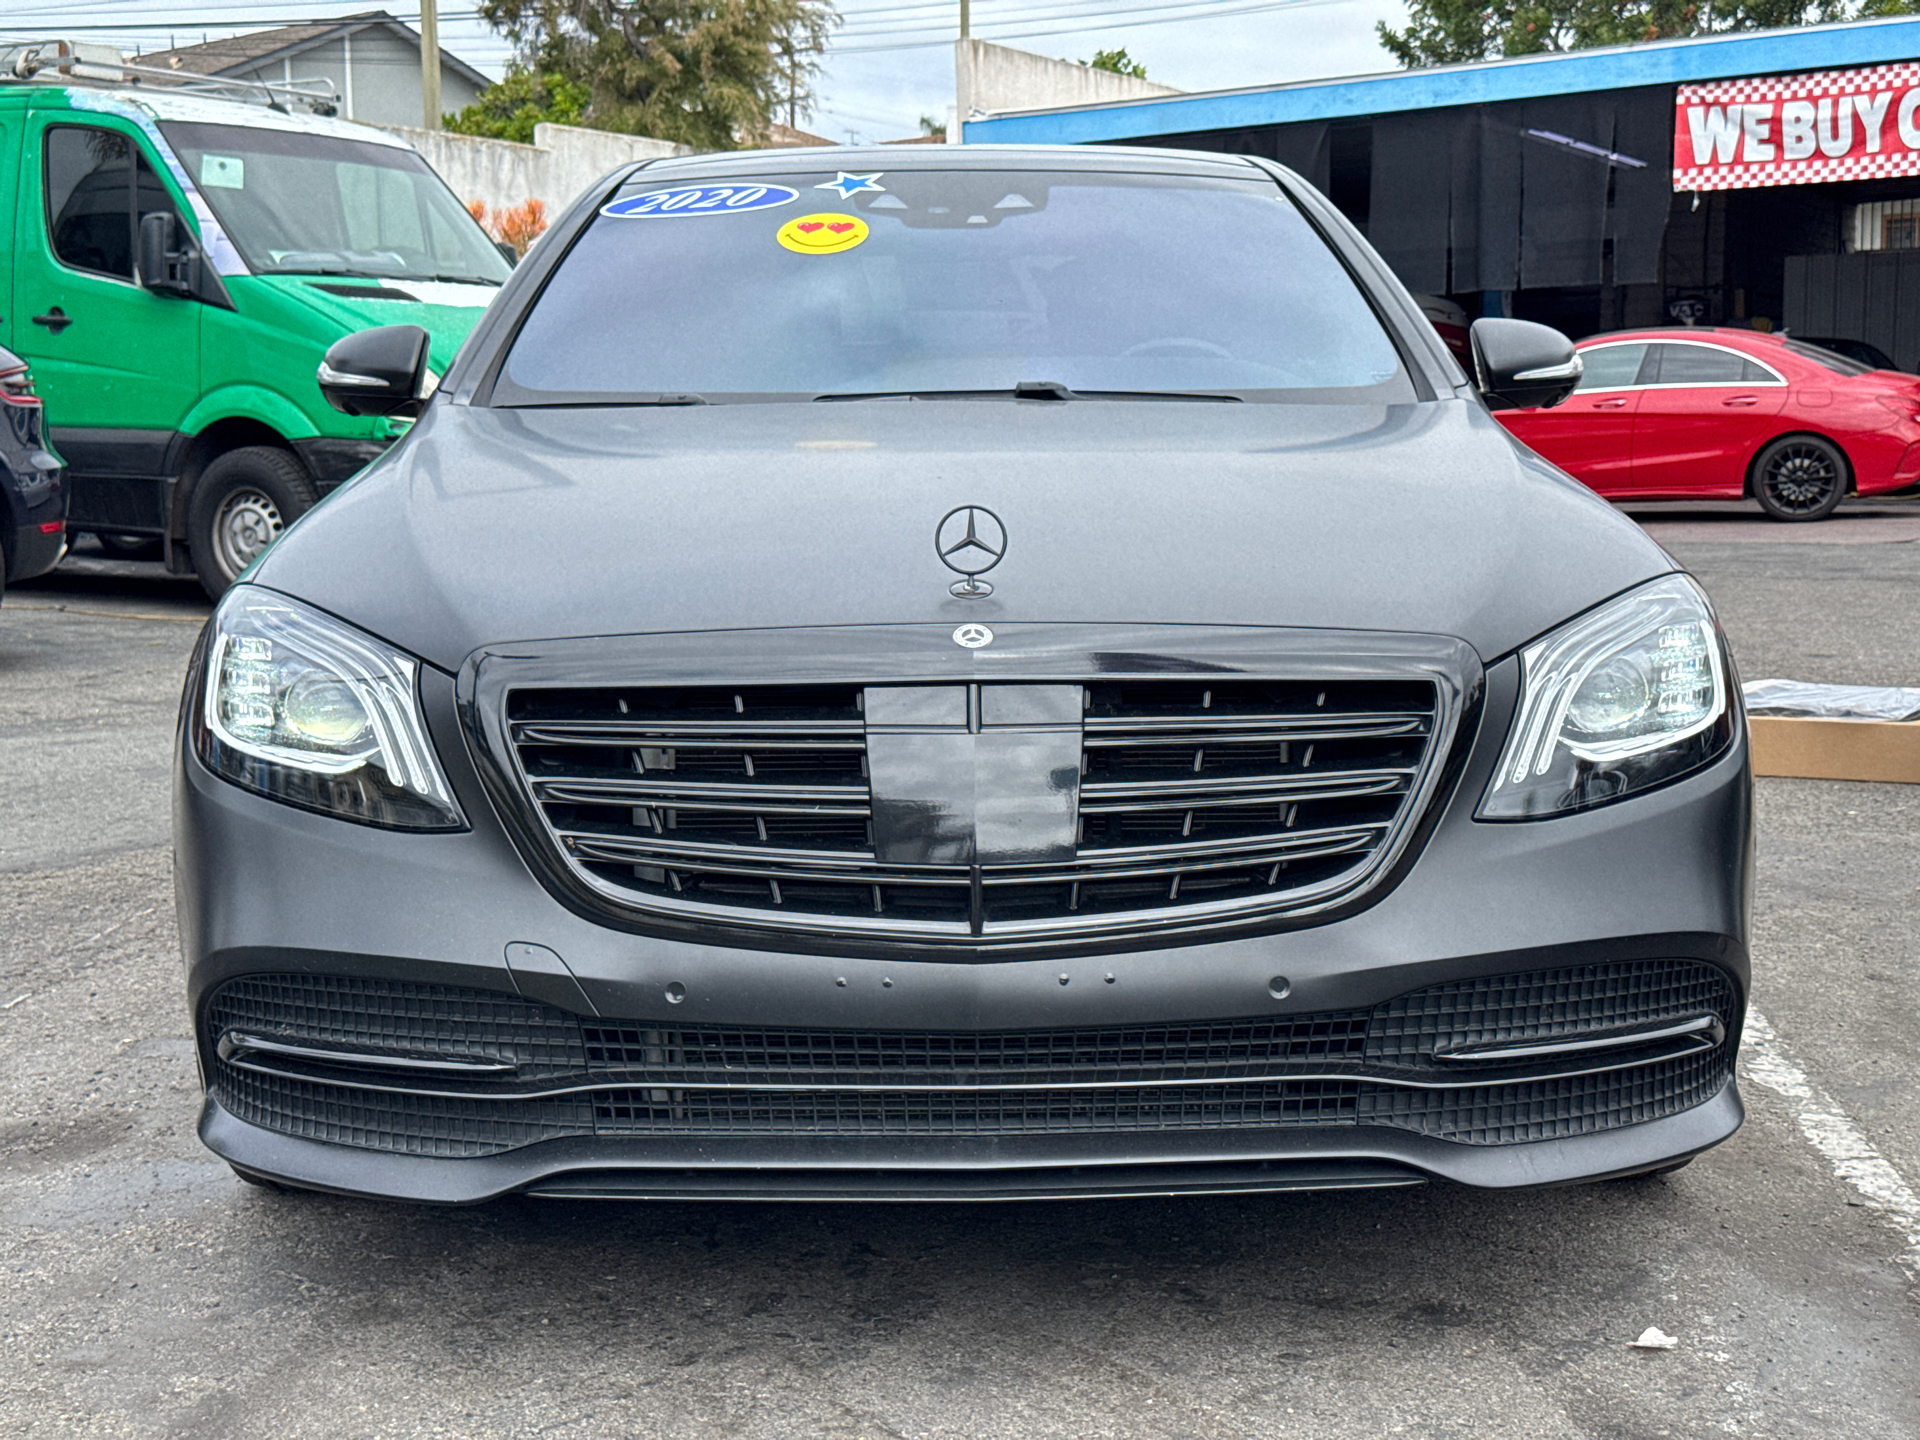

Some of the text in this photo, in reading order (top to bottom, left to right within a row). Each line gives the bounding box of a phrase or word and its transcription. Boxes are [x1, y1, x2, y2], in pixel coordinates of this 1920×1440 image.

[1686, 103, 1775, 165] WE
[1781, 91, 1894, 161] BUY
[625, 187, 767, 214] 2020
